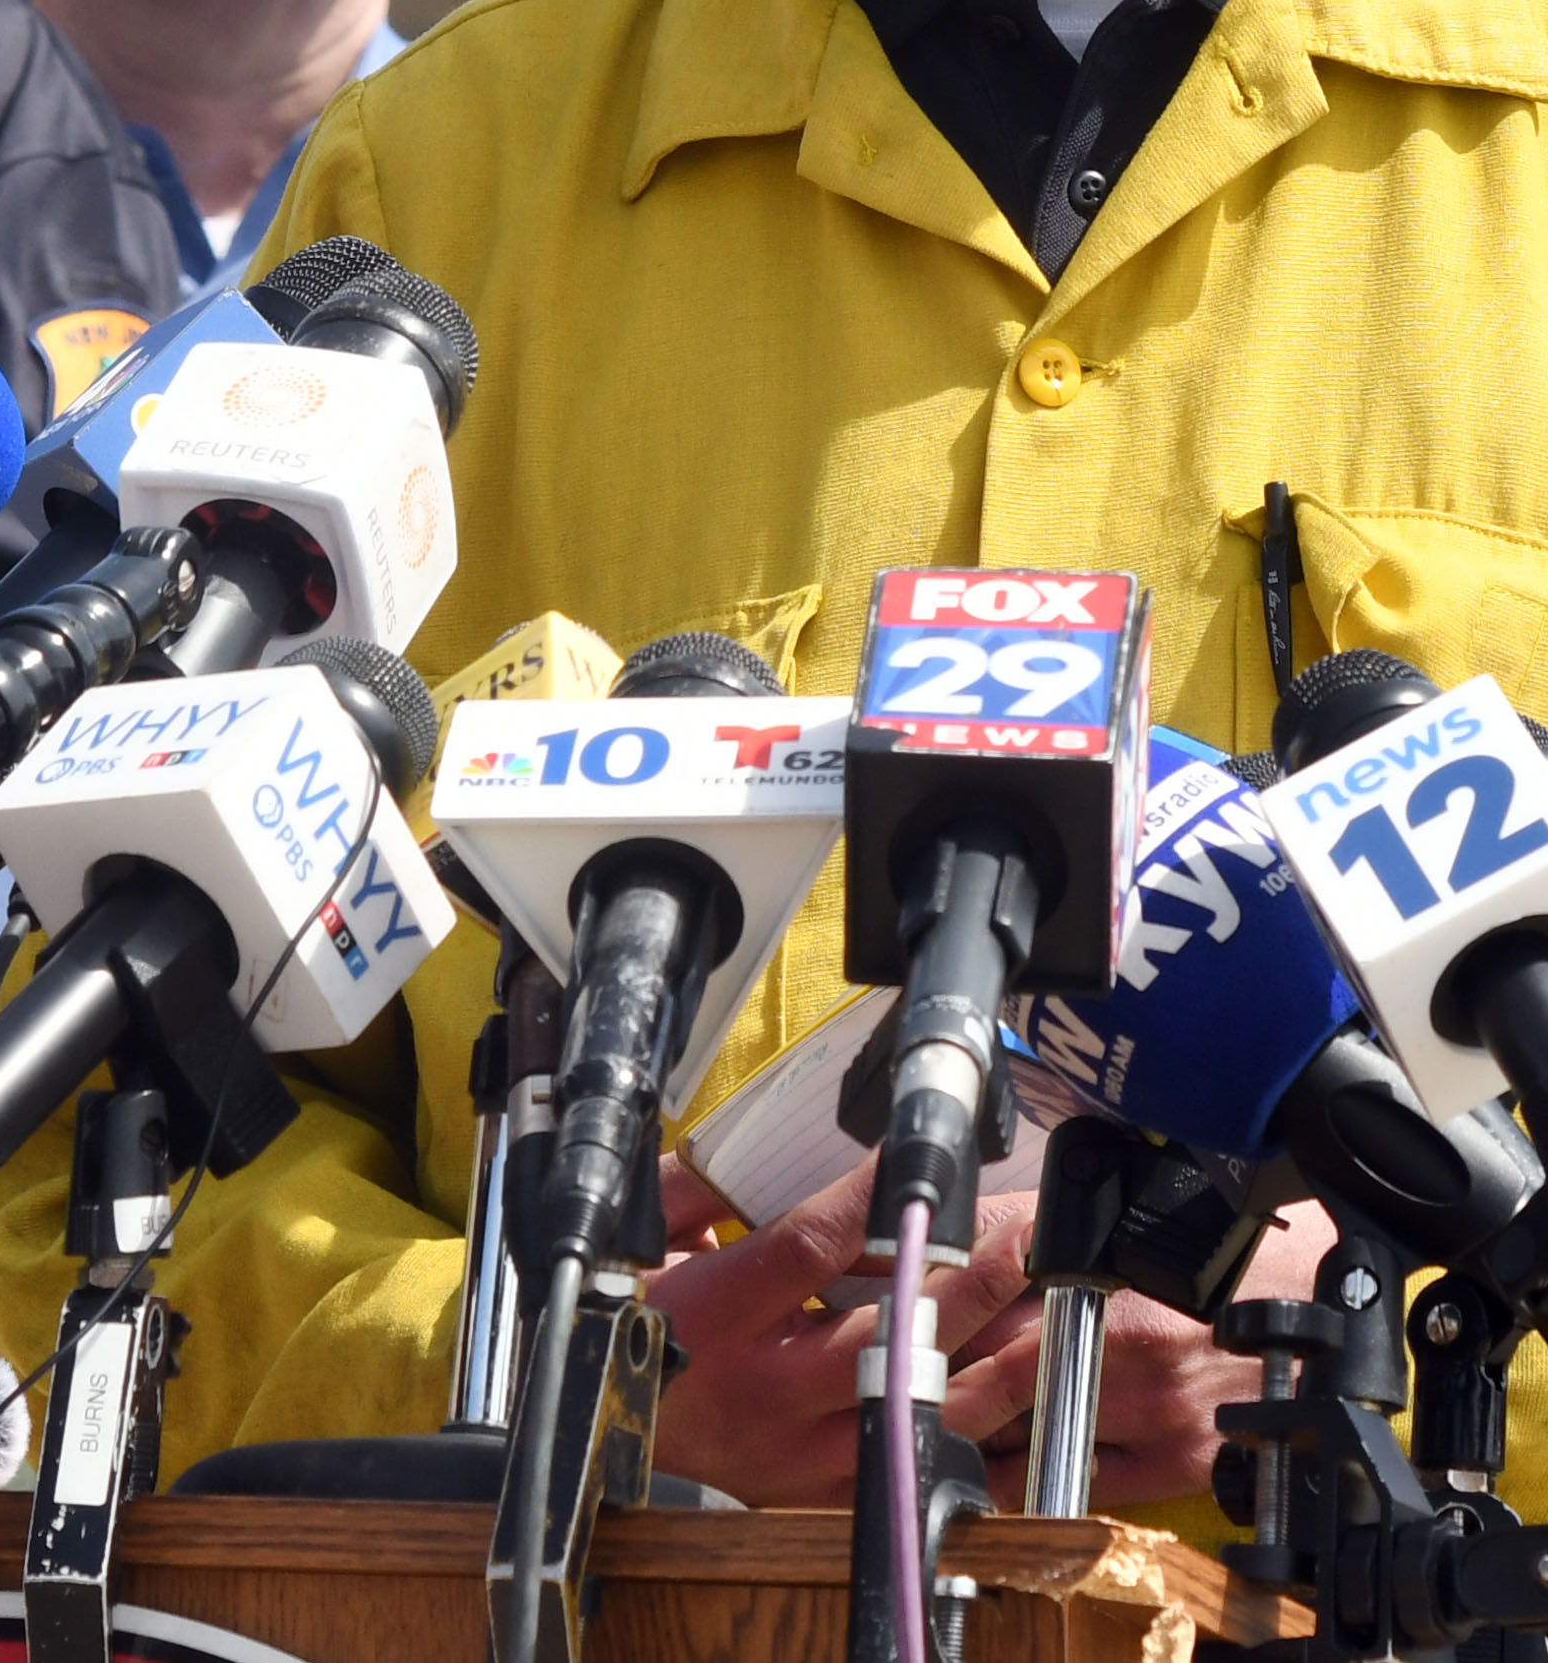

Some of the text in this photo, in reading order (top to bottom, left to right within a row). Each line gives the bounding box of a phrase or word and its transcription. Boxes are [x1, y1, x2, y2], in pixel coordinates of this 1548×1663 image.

[169, 439, 312, 469] REUTERS
[366, 506, 398, 636] REUTERS
[909, 577, 1099, 624] FOX
[880, 636, 1103, 718] 29
[57, 696, 270, 753] WHYY
[71, 755, 124, 778] PBS
[536, 726, 671, 787] 10
[701, 775, 845, 786] TELEMUNDO
[783, 750, 845, 771] 62
[1294, 705, 1483, 826] news
[275, 715, 422, 954] WHYY
[275, 824, 315, 883] PBS
[80, 1372, 109, 1454] BURNS
